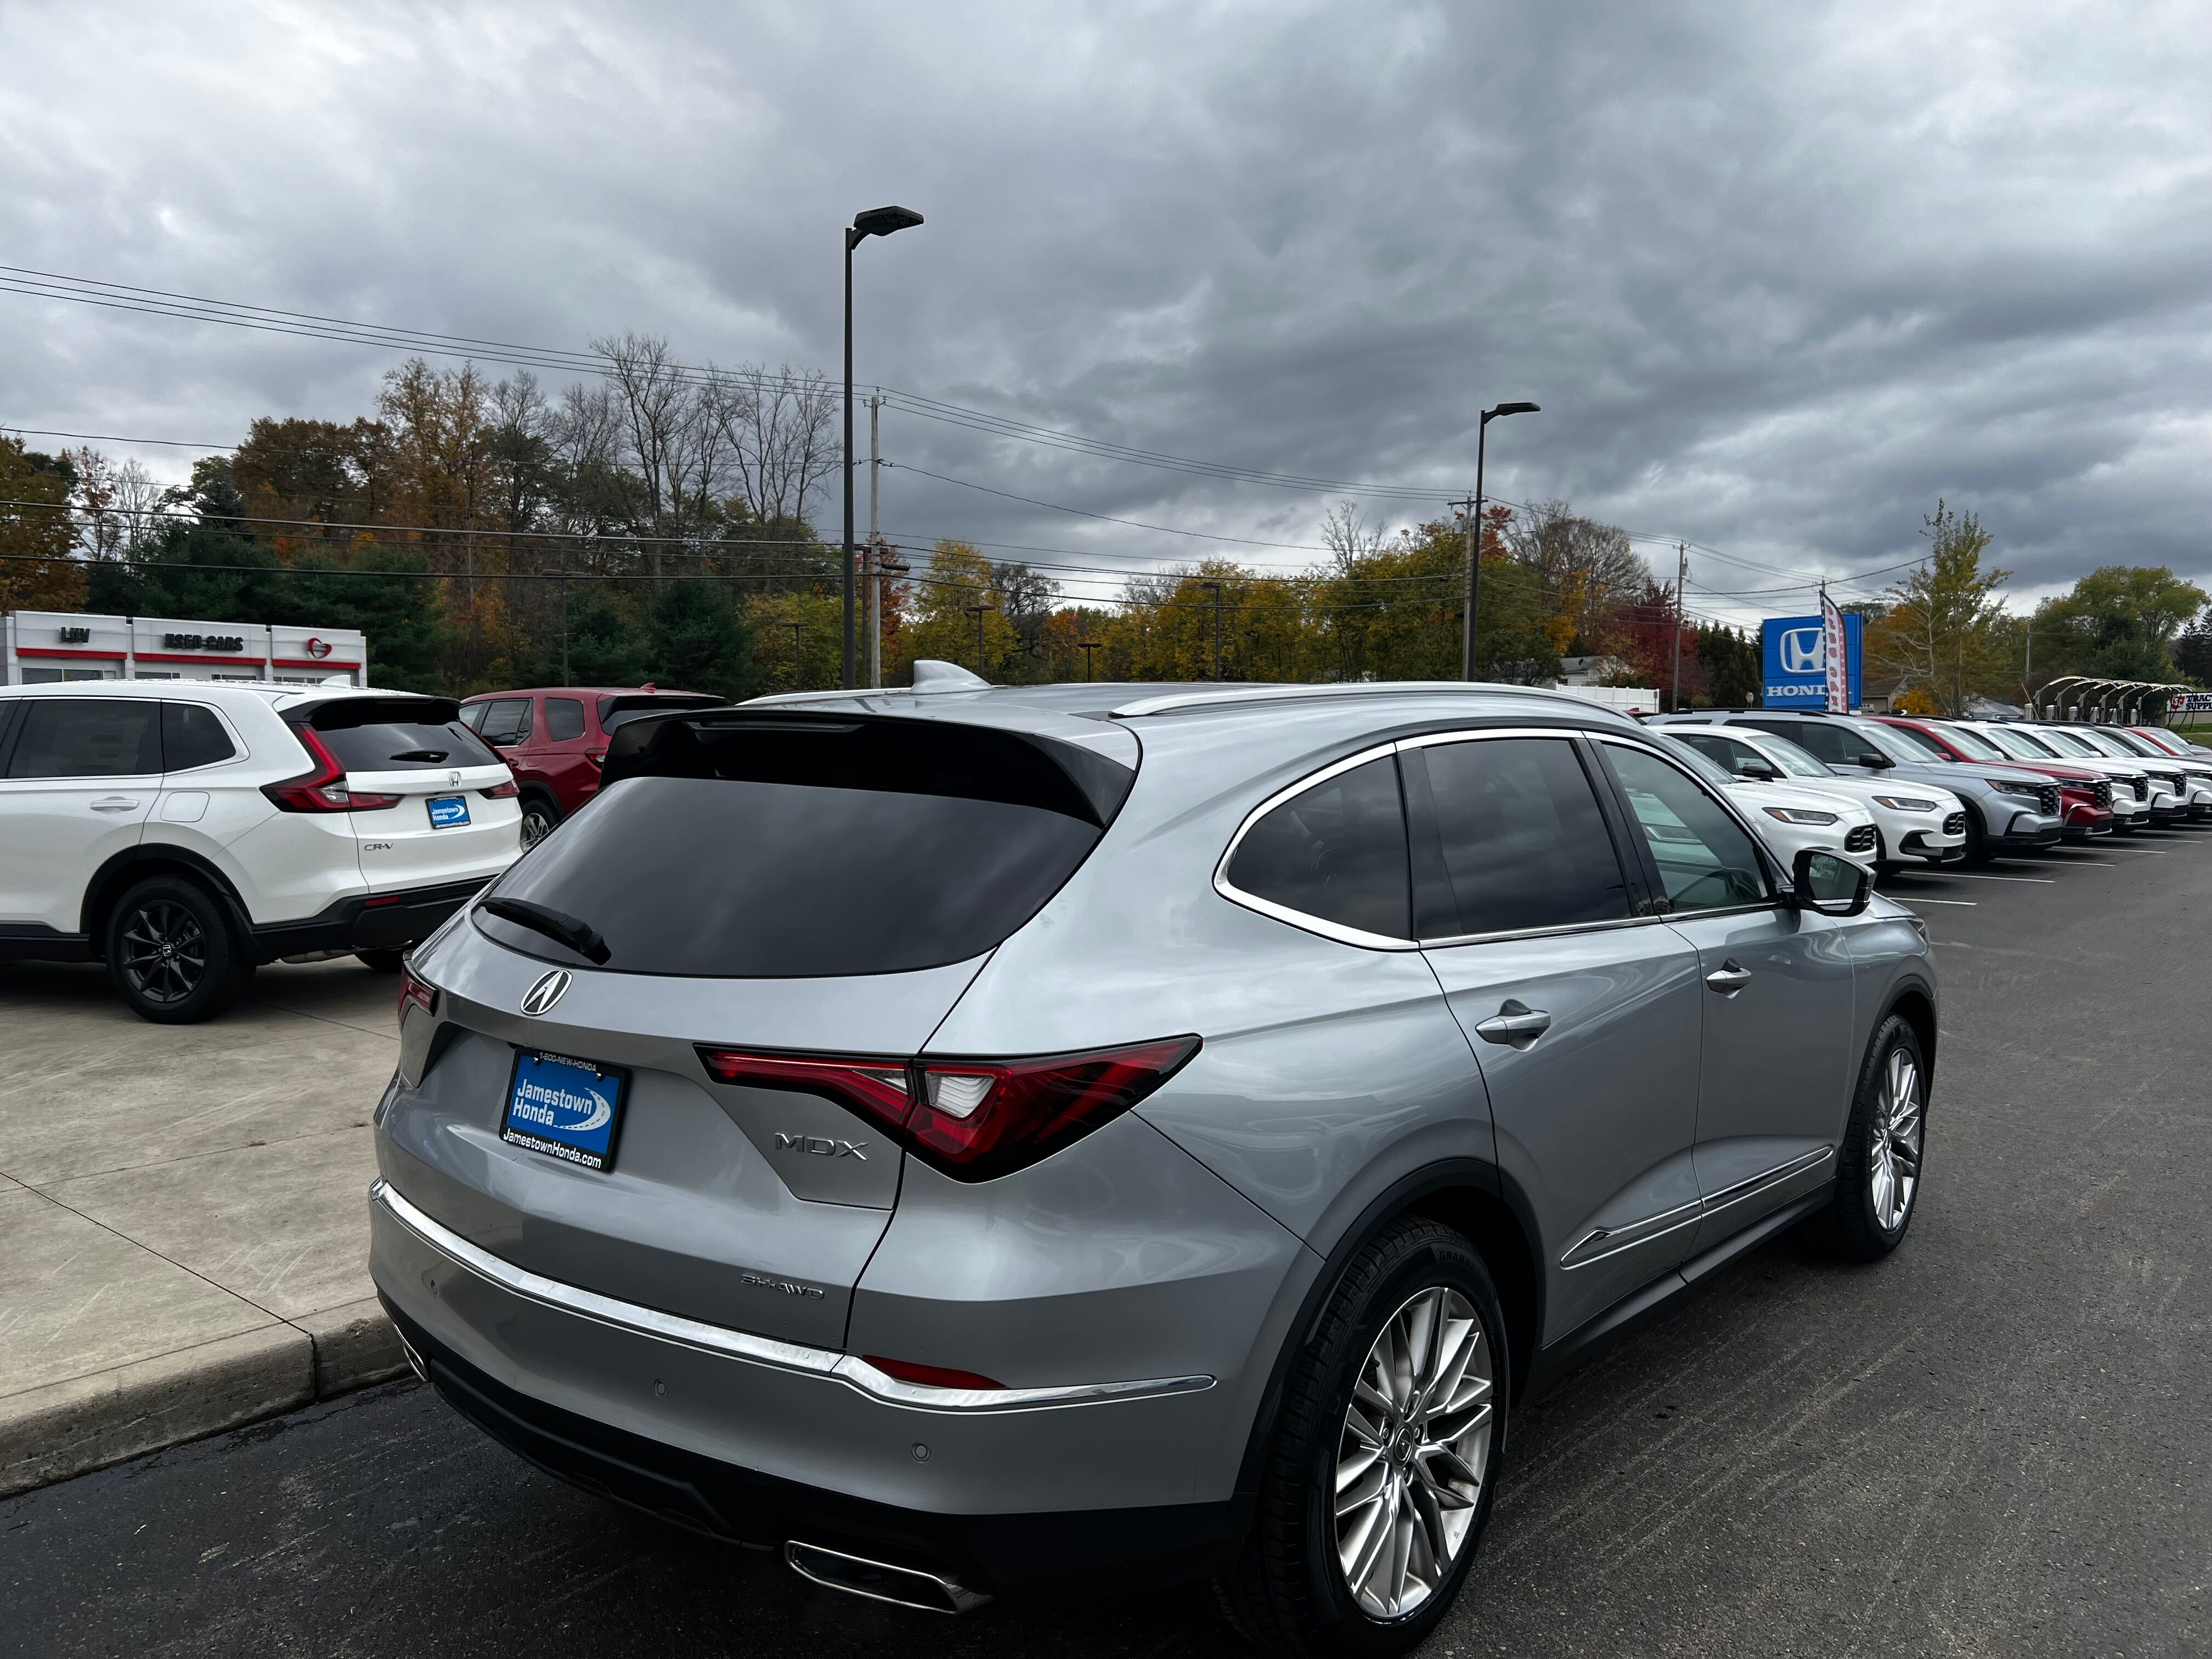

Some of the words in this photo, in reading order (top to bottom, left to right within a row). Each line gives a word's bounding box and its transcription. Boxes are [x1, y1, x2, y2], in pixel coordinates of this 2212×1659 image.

[166, 633, 202, 648] USED
[207, 635, 244, 651] CARS
[1767, 685, 1852, 697] HOND
[364, 843, 393, 851] CR-V
[539, 1052, 596, 1072] 1-800-NEW-HONDA
[517, 1079, 593, 1115] Jamestown
[512, 1097, 555, 1126] Honda
[503, 1128, 602, 1169] JamestownHonda.com
[775, 1132, 869, 1160] MDX
